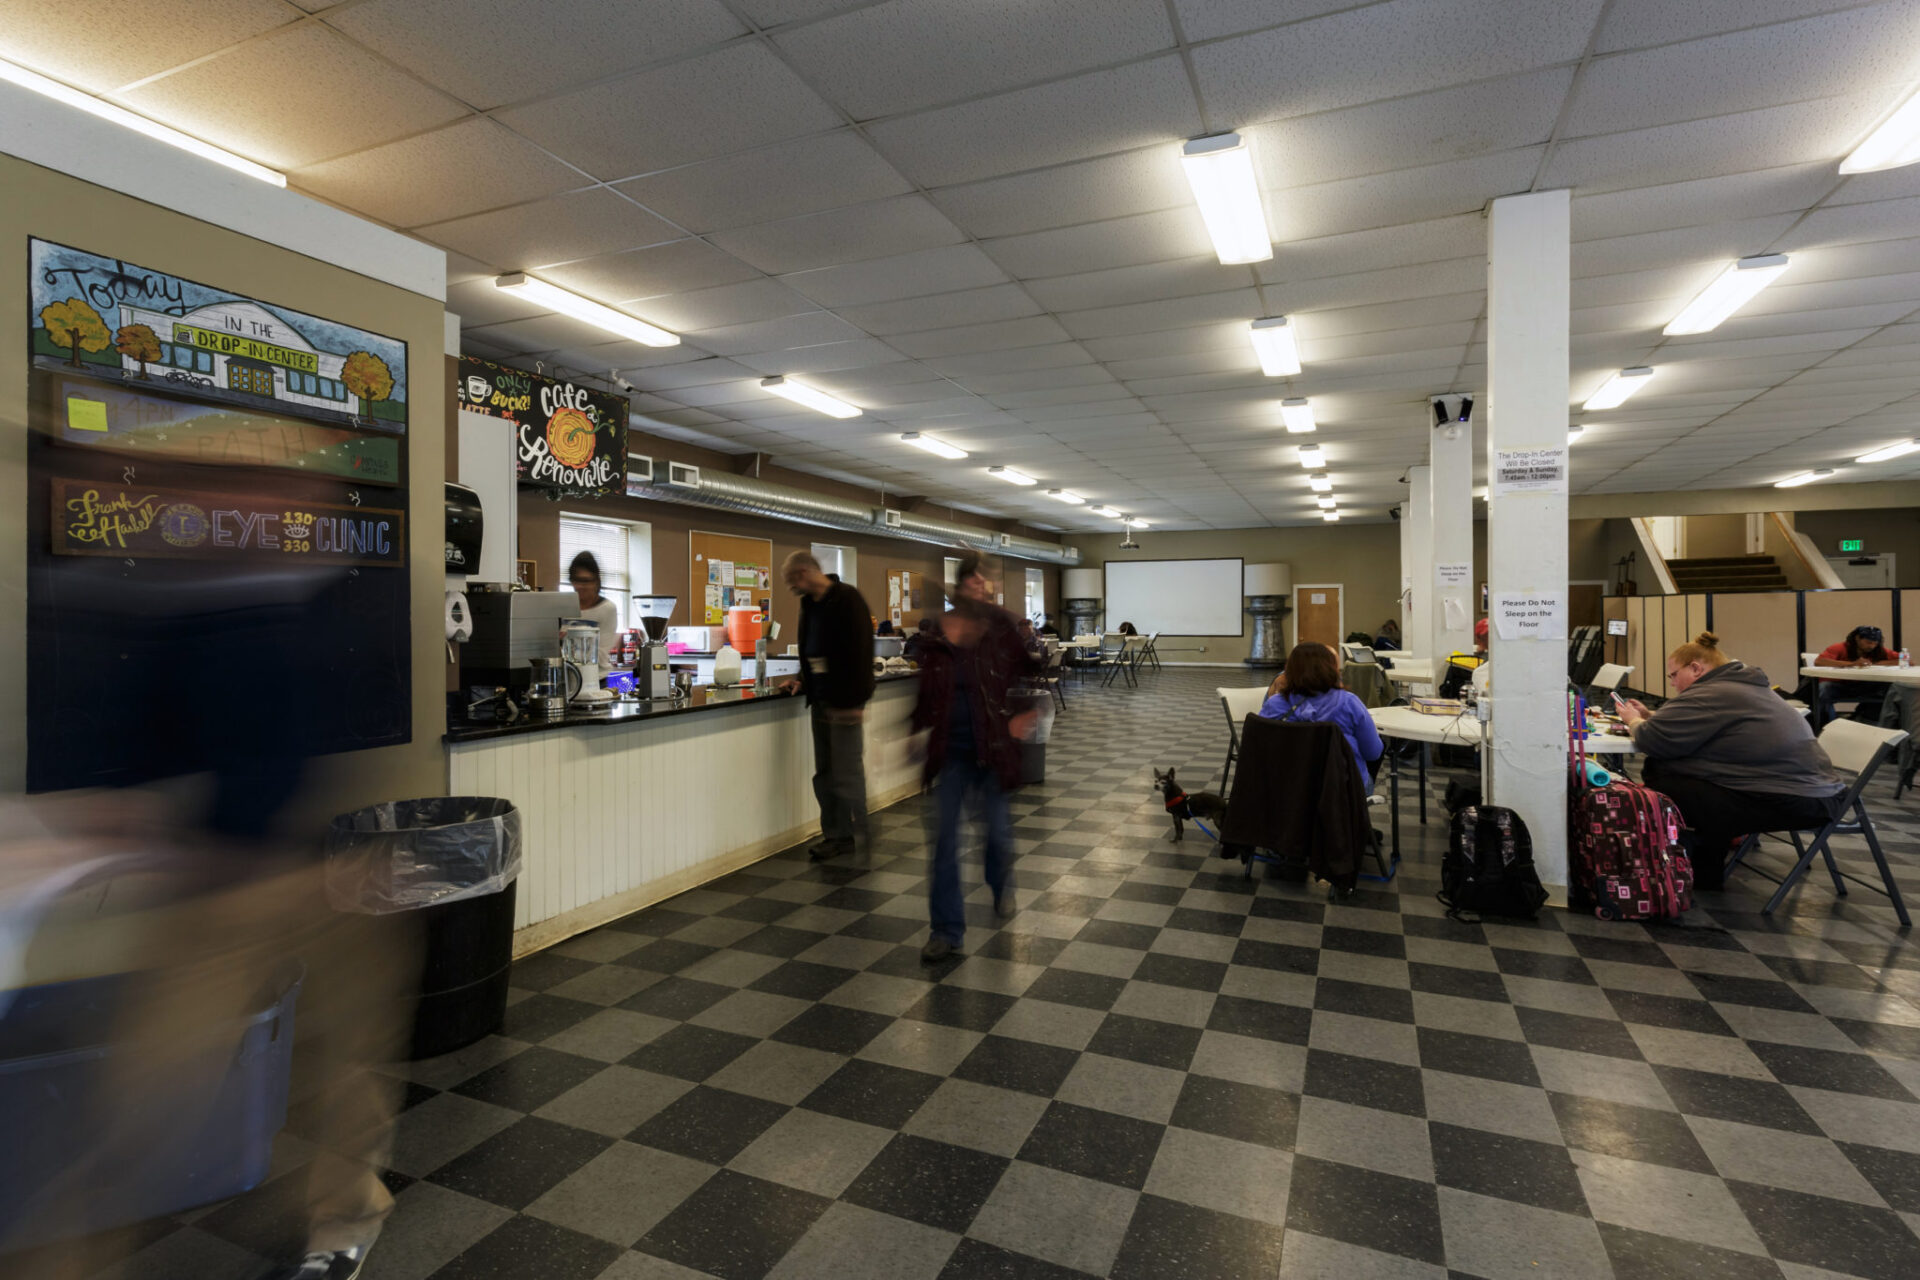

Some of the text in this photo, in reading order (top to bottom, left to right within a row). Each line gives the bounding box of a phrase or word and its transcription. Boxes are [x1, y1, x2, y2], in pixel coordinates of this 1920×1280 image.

[45, 260, 199, 315] Today
[225, 316, 273, 338] IN THE
[199, 331, 314, 370] DROP-IN CENTER
[496, 375, 531, 394] ONLY
[490, 390, 531, 411] BUCK?!
[519, 424, 619, 488] Renovate
[1513, 451, 1538, 459] Drop-In
[67, 489, 159, 528] Frank
[212, 510, 280, 549] EYE
[316, 517, 390, 554] CLINIC
[283, 540, 310, 552] 330
[1842, 540, 1861, 551] EXIT
[1505, 610, 1526, 618] Sleep
